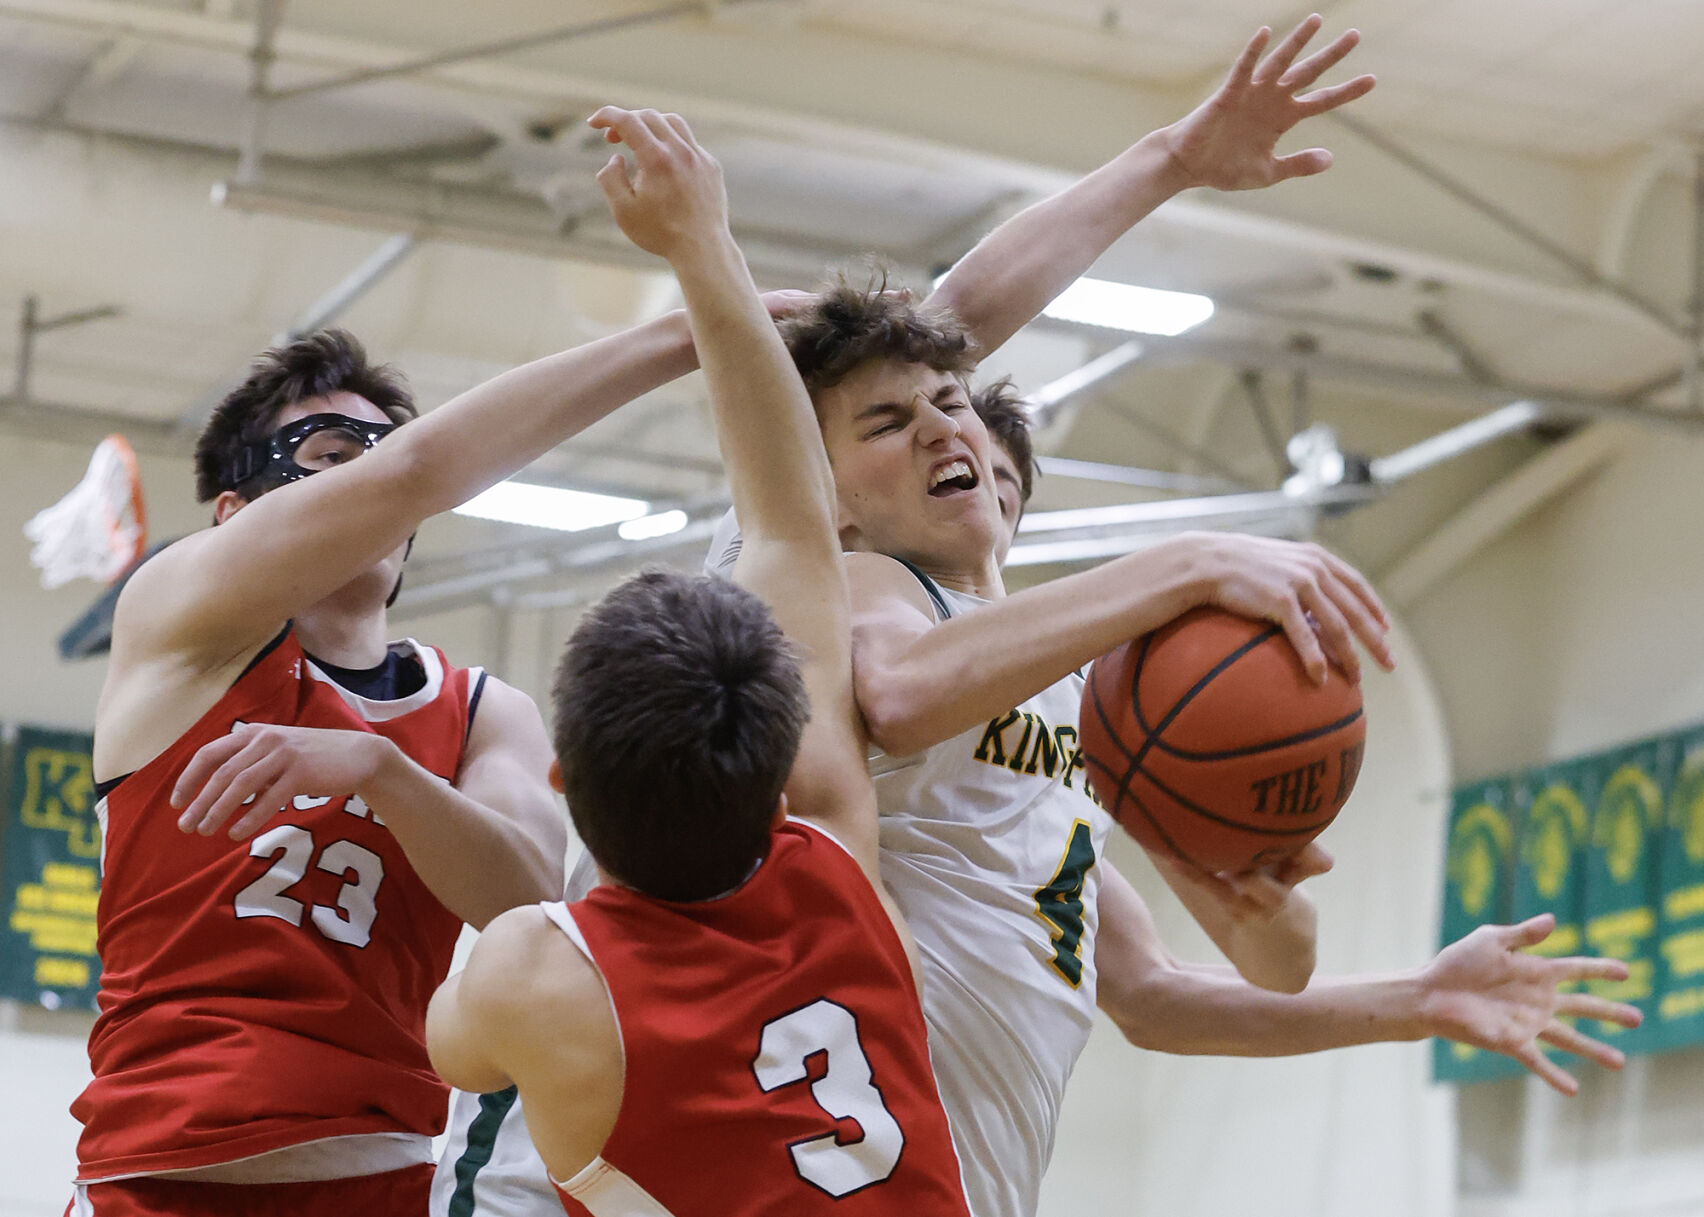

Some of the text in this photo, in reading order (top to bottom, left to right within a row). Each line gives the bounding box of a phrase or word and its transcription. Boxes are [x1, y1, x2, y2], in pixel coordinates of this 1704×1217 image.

[1251, 757, 1327, 816] THE
[234, 823, 385, 949] 23
[1032, 817, 1096, 992] 4
[750, 996, 906, 1201] 3
